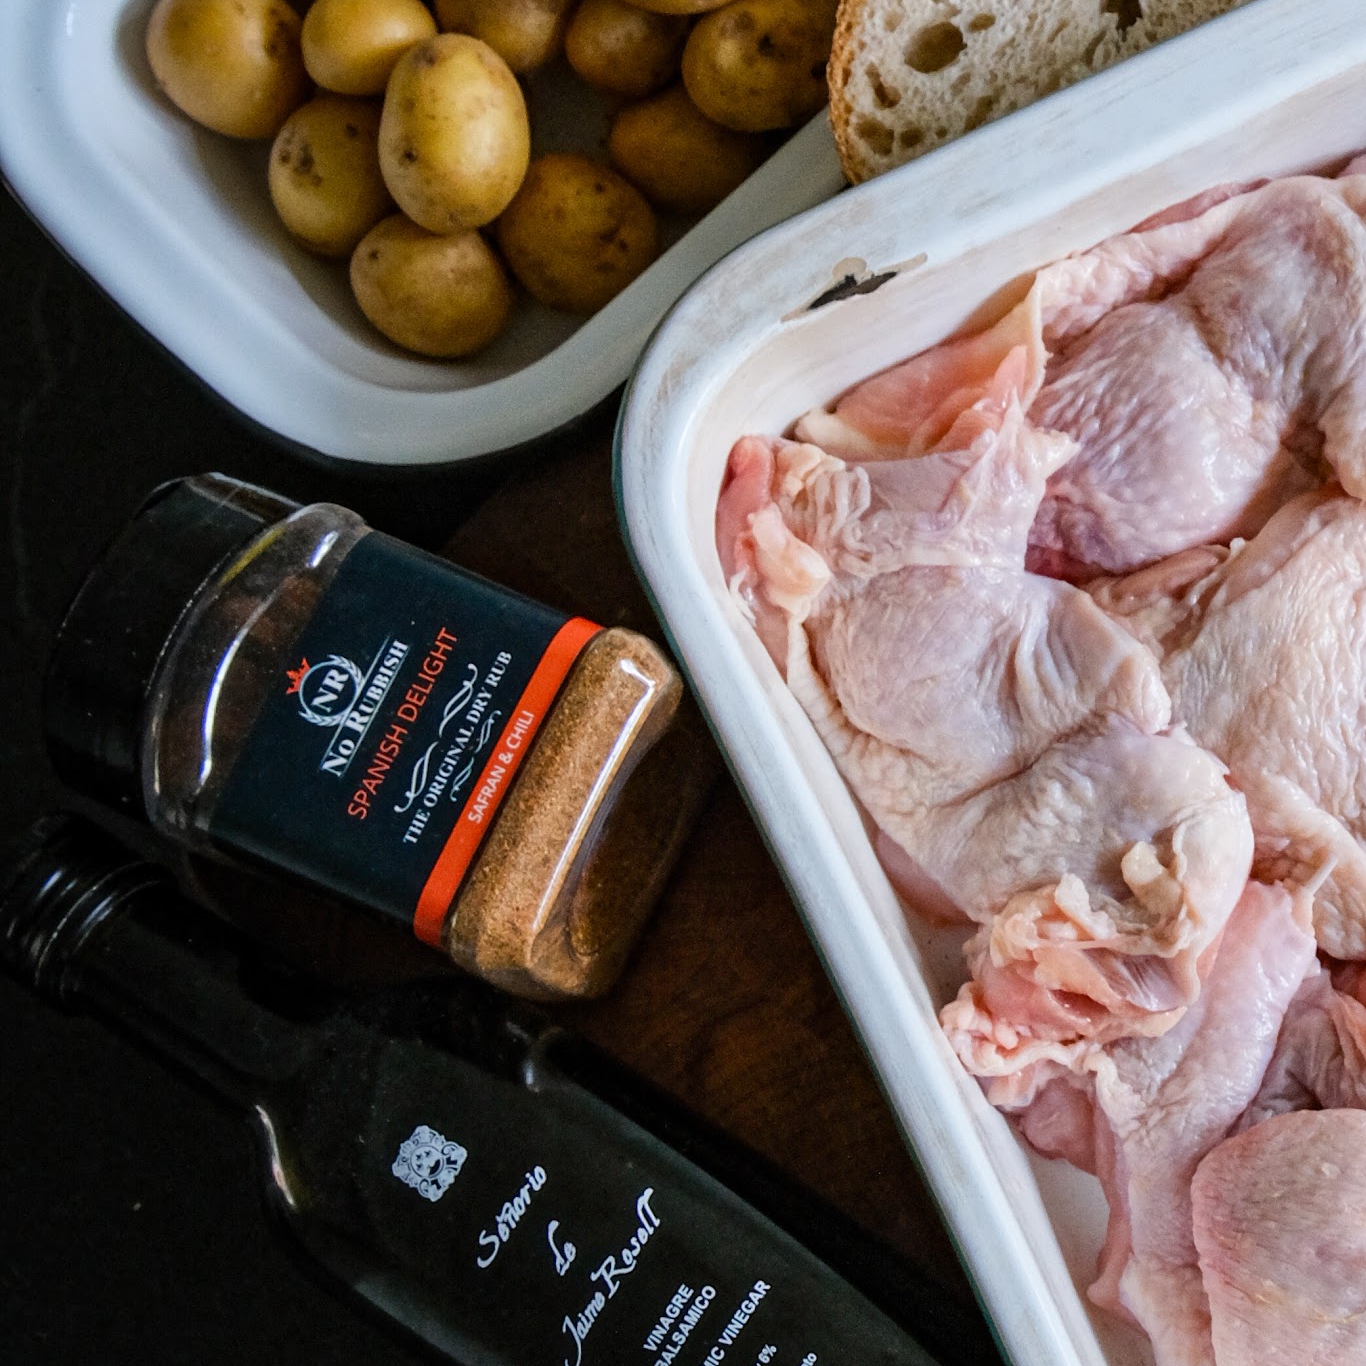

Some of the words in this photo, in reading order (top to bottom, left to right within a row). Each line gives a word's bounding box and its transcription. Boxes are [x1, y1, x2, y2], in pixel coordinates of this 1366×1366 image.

[311, 669, 350, 712] NR
[346, 640, 408, 733] RUBBISH
[347, 724, 408, 819] SPANISH
[397, 627, 457, 721] DELIGHT
[403, 809, 431, 844] THE
[423, 726, 473, 808] ORIGINAL
[466, 688, 492, 726] DRY
[485, 651, 512, 687] RUB
[468, 765, 506, 824] SAFRAN
[499, 752, 513, 766] &
[506, 710, 535, 749] CHILI
[590, 1187, 661, 1299] Rosell
[643, 1283, 695, 1353] VINAGRE
[718, 1279, 772, 1347] VINEGAR
[758, 1343, 777, 1366] 6%
